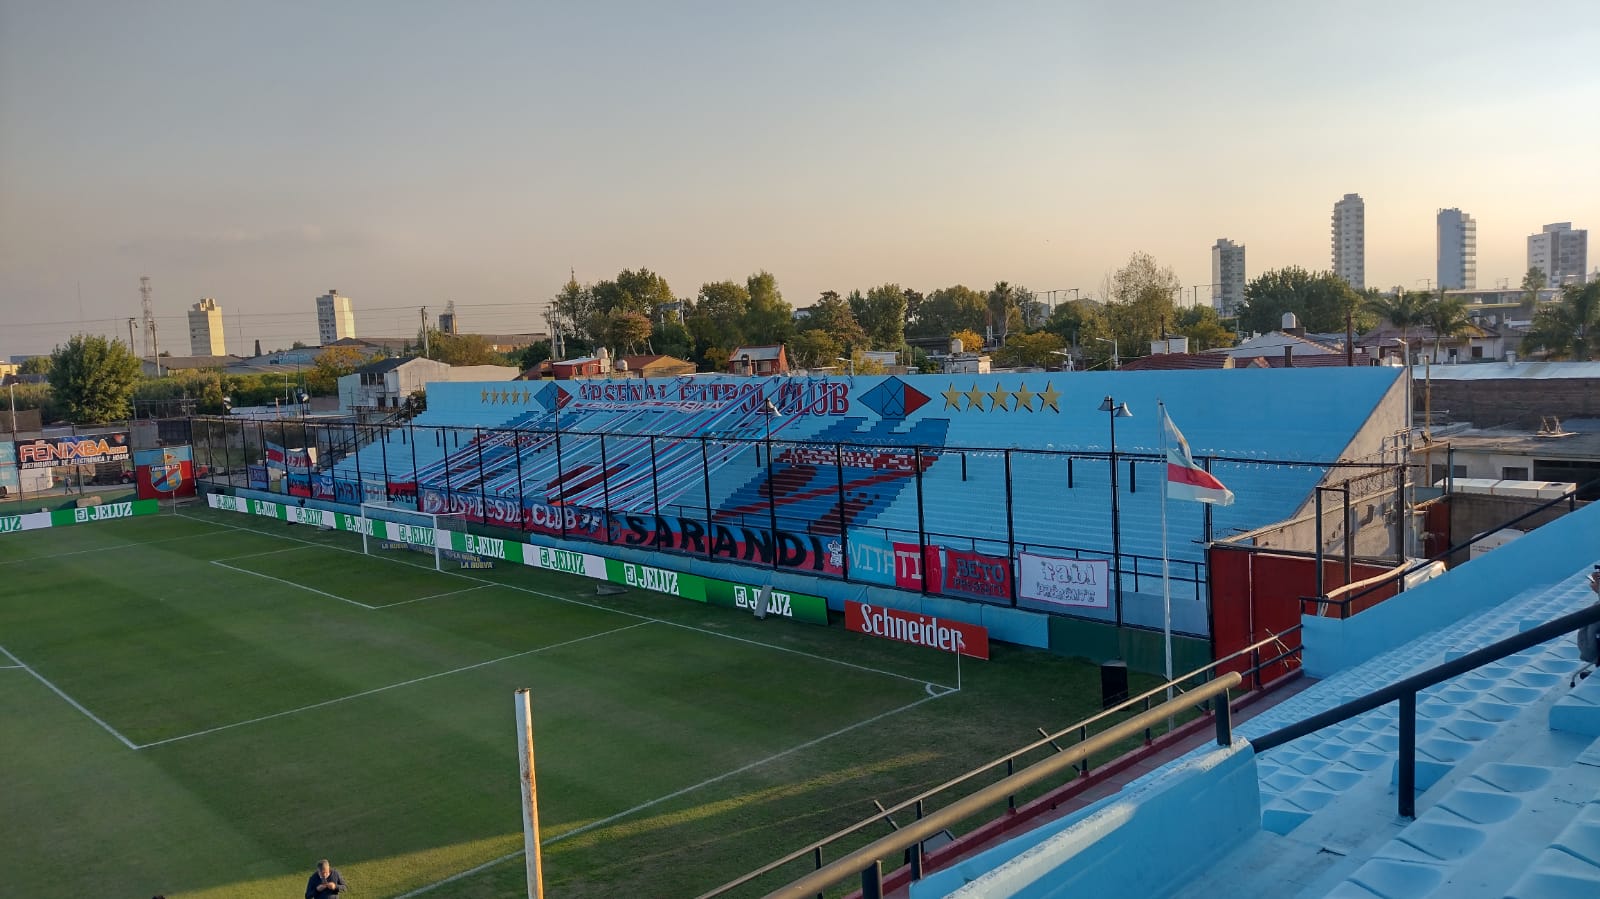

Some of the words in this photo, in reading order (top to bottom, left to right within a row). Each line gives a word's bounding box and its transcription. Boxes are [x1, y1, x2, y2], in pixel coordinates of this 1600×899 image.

[579, 384, 667, 401] ARSENAL
[779, 382, 849, 416] CLUB
[90, 502, 132, 520] JELUZ
[443, 493, 466, 514] LOS
[531, 503, 576, 530] CLUB
[475, 535, 505, 559] JELUZ
[625, 516, 824, 571] SARANDI
[551, 549, 585, 575] JELUZ
[956, 557, 1005, 583] BETO
[638, 565, 680, 596] JELUZ
[860, 603, 965, 652] Schneider
